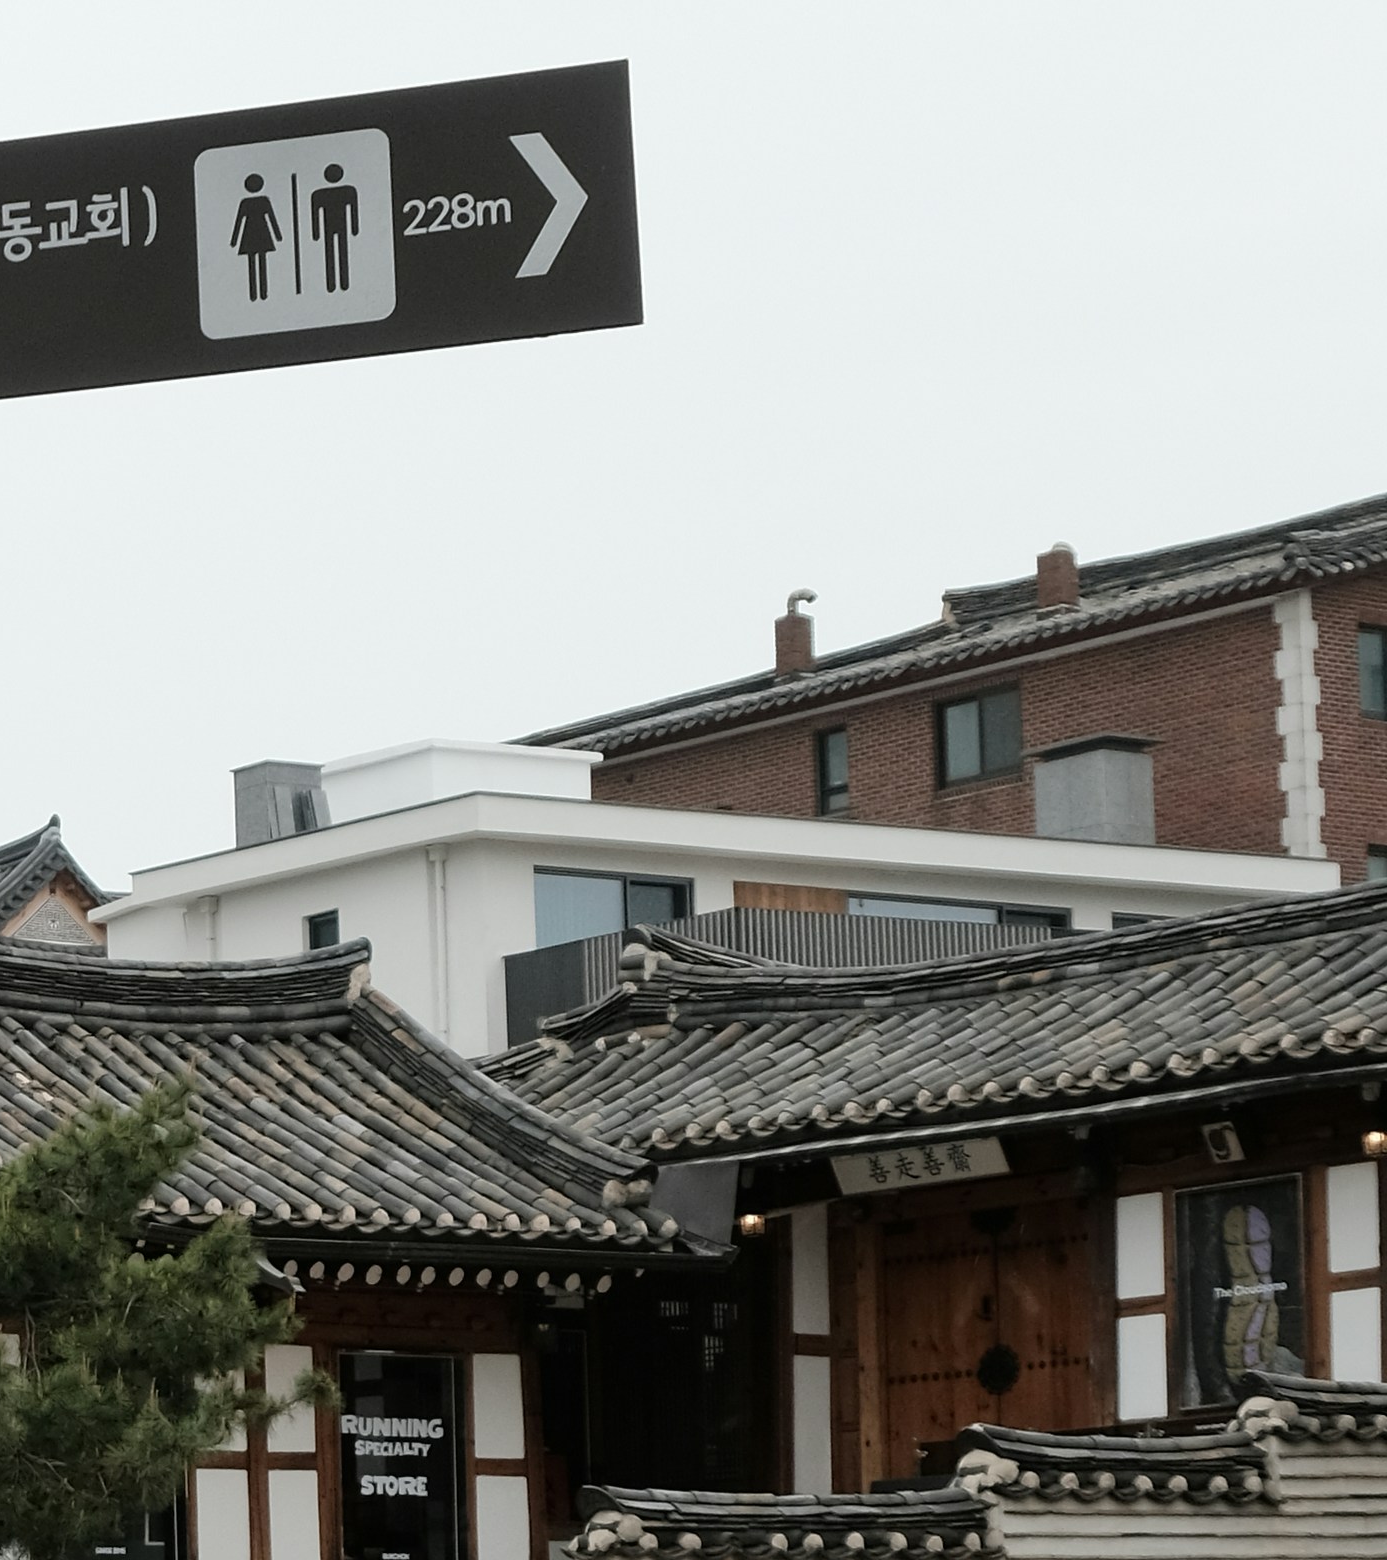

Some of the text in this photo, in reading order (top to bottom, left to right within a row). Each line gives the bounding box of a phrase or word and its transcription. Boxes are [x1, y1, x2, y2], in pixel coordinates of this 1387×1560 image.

[403, 193, 511, 235] 228m
[341, 1415, 443, 1438] RUNNING
[355, 1440, 430, 1456] SPECIALTY
[361, 1475, 427, 1496] STORE
